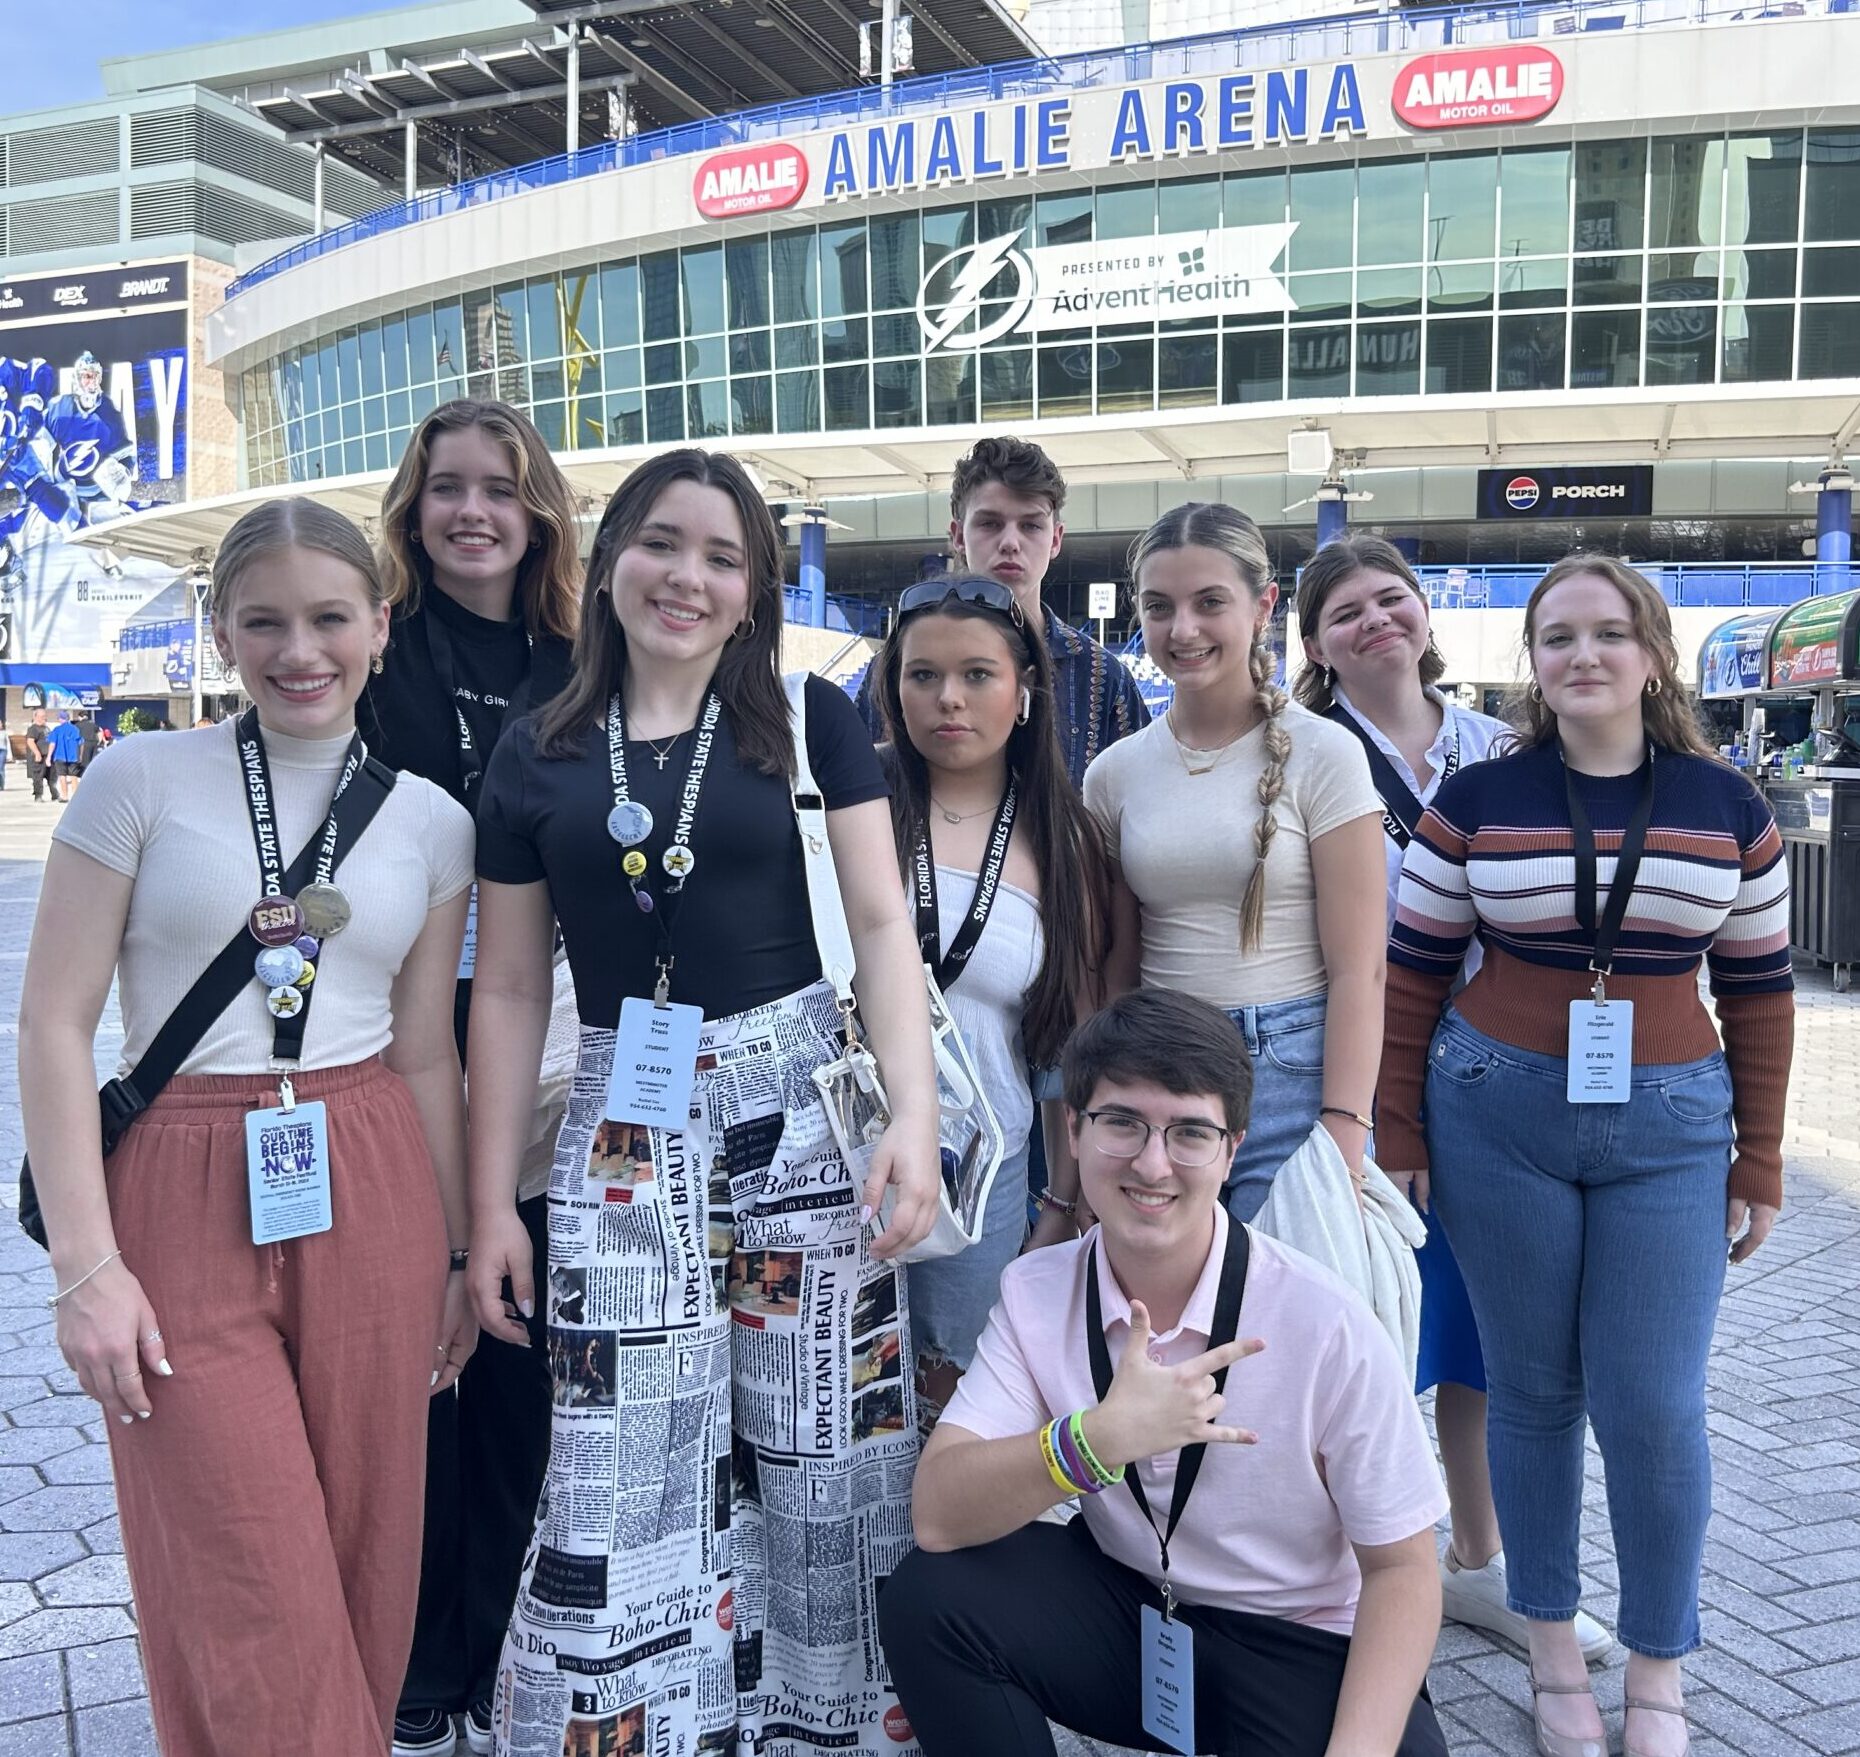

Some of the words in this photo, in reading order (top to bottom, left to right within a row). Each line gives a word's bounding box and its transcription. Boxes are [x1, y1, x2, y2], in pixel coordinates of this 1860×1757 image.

[1404, 61, 1553, 108] AMALIE
[1440, 105, 1487, 120] MOTOR
[1491, 102, 1514, 115] OIL
[822, 97, 1073, 200] AMALIE
[1109, 61, 1368, 162] ARENA
[701, 156, 798, 201] AMALIE
[724, 195, 756, 209] MOTOR
[757, 193, 773, 204] OIL
[1062, 257, 1140, 276] PRESENTED
[1148, 255, 1165, 268] BY
[54, 285, 86, 302] DEX
[1052, 273, 1250, 314] AdventHealth
[1508, 488, 1537, 497] PEPSI
[1552, 484, 1625, 499] PORCH
[453, 687, 479, 702] ABY
[692, 730, 712, 769] STATE
[242, 740, 271, 821] THESPIANS
[610, 750, 628, 787] STATE
[674, 766, 704, 845] THESPIANS
[1381, 814, 1401, 836] FLO
[257, 824, 280, 869] STATE
[990, 823, 1009, 860] STATE
[916, 853, 933, 908] FLORIDA
[973, 858, 1001, 922] THESPIANS
[651, 1019, 670, 1029] Story
[717, 1001, 783, 1025] DECORATING
[645, 1044, 669, 1053] STUDENT
[719, 1046, 746, 1063] WHEN
[746, 1044, 759, 1056] TO
[759, 1040, 772, 1053] GO
[1585, 1052, 1615, 1060] 07-8570
[635, 1063, 672, 1076] 07-8570
[260, 1131, 286, 1145] OUR
[288, 1127, 314, 1141] TIME
[261, 1123, 282, 1133] Florida
[282, 1120, 312, 1130] Thespians
[261, 1137, 315, 1159] BEGINS
[810, 1147, 842, 1164] Guid
[264, 1150, 313, 1178] NOW
[665, 1131, 690, 1207] BEAUTY
[694, 1175, 702, 1193] FOR
[760, 1162, 852, 1196] Boho-Ch
[660, 1199, 673, 1230] Studio
[694, 1193, 705, 1234] DRESSING
[810, 1206, 862, 1222] DECORATI
[667, 1230, 675, 1241] of
[745, 1216, 793, 1239] What
[748, 1236, 762, 1247] to
[767, 1231, 806, 1246] know
[698, 1234, 706, 1260] WHILE
[806, 1250, 831, 1262] WHEN
[832, 1246, 844, 1259] TO
[844, 1243, 856, 1256] GO
[669, 1243, 680, 1282] Vintage
[673, 1212, 700, 1319] EXPECTANT
[703, 1293, 713, 1317] LOOK
[814, 1269, 836, 1342] BEAUTY
[839, 1308, 848, 1328] FOR
[677, 1323, 726, 1344] INSPIRED
[798, 1333, 808, 1362] Studio
[838, 1328, 848, 1369] DRESSING
[800, 1363, 808, 1374] of
[799, 1376, 809, 1410] Vintage
[839, 1370, 848, 1395] WHILE
[814, 1348, 833, 1450] EXPECTANT
[839, 1396, 848, 1424] GOOD
[704, 1414, 712, 1430] for
[701, 1430, 711, 1466] Session
[839, 1425, 848, 1449] LOOK
[808, 1446, 863, 1473] INSPIRED
[864, 1444, 878, 1459] BY
[882, 1438, 917, 1456] ICONS
[701, 1465, 710, 1501] Special
[699, 1502, 709, 1527] Ends
[700, 1529, 711, 1575] Congress
[858, 1550, 867, 1584] Session
[625, 1601, 654, 1619] Your
[656, 1585, 694, 1607] Guide
[698, 1584, 712, 1595] to
[859, 1584, 869, 1617] Special
[606, 1598, 713, 1649] Boho-Chic
[861, 1617, 870, 1640] Ends
[651, 1645, 713, 1669] DECORATING
[863, 1640, 874, 1683] Congress
[594, 1668, 638, 1698] What
[602, 1694, 617, 1710] to
[619, 1681, 648, 1705] know
[667, 1689, 678, 1701] TO
[679, 1685, 691, 1698] GO
[781, 1680, 812, 1702] Your
[815, 1690, 858, 1707] Guide
[862, 1688, 879, 1701] to
[583, 1695, 593, 1712] 3
[694, 1706, 733, 1723] FASHION
[763, 1694, 879, 1728] Boho-Chic
